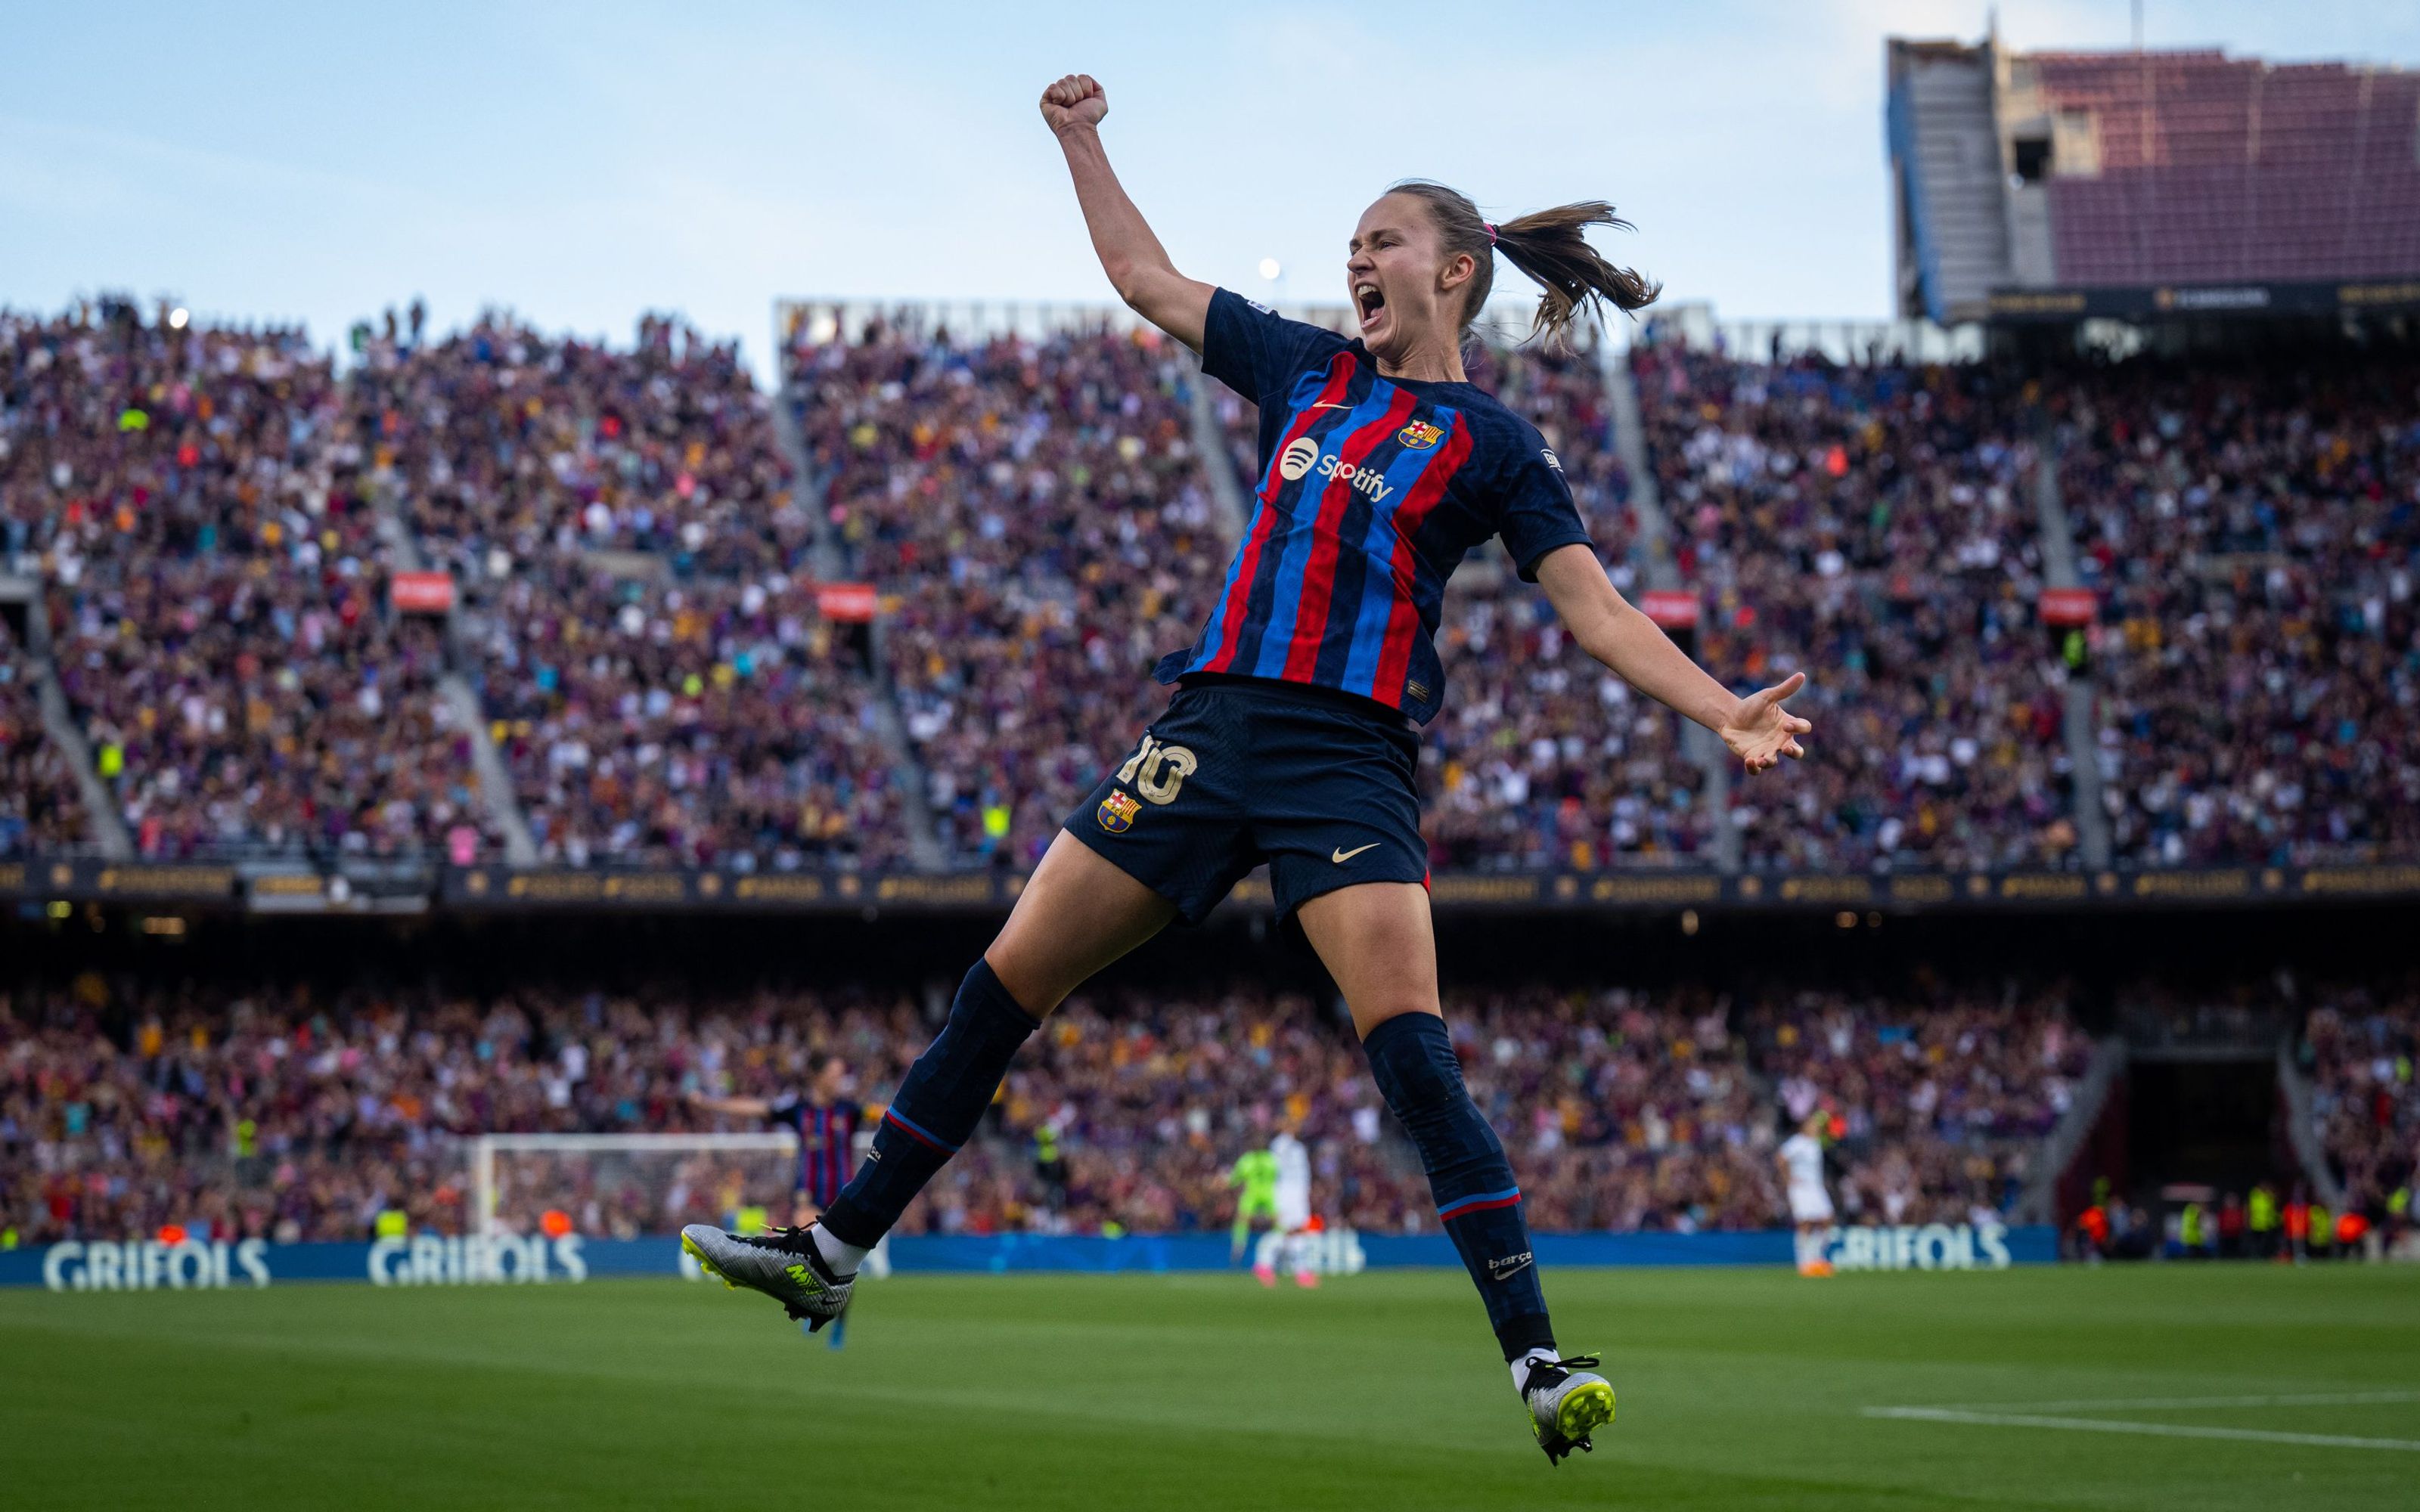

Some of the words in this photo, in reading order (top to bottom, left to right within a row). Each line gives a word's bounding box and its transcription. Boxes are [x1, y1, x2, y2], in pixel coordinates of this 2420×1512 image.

[1317, 454, 1394, 503] Spotify
[1116, 731, 1197, 805] 10
[43, 1238, 271, 1290] GRIFOLS
[367, 1233, 588, 1285] GRIFOLS
[1488, 1251, 1531, 1269] barça
